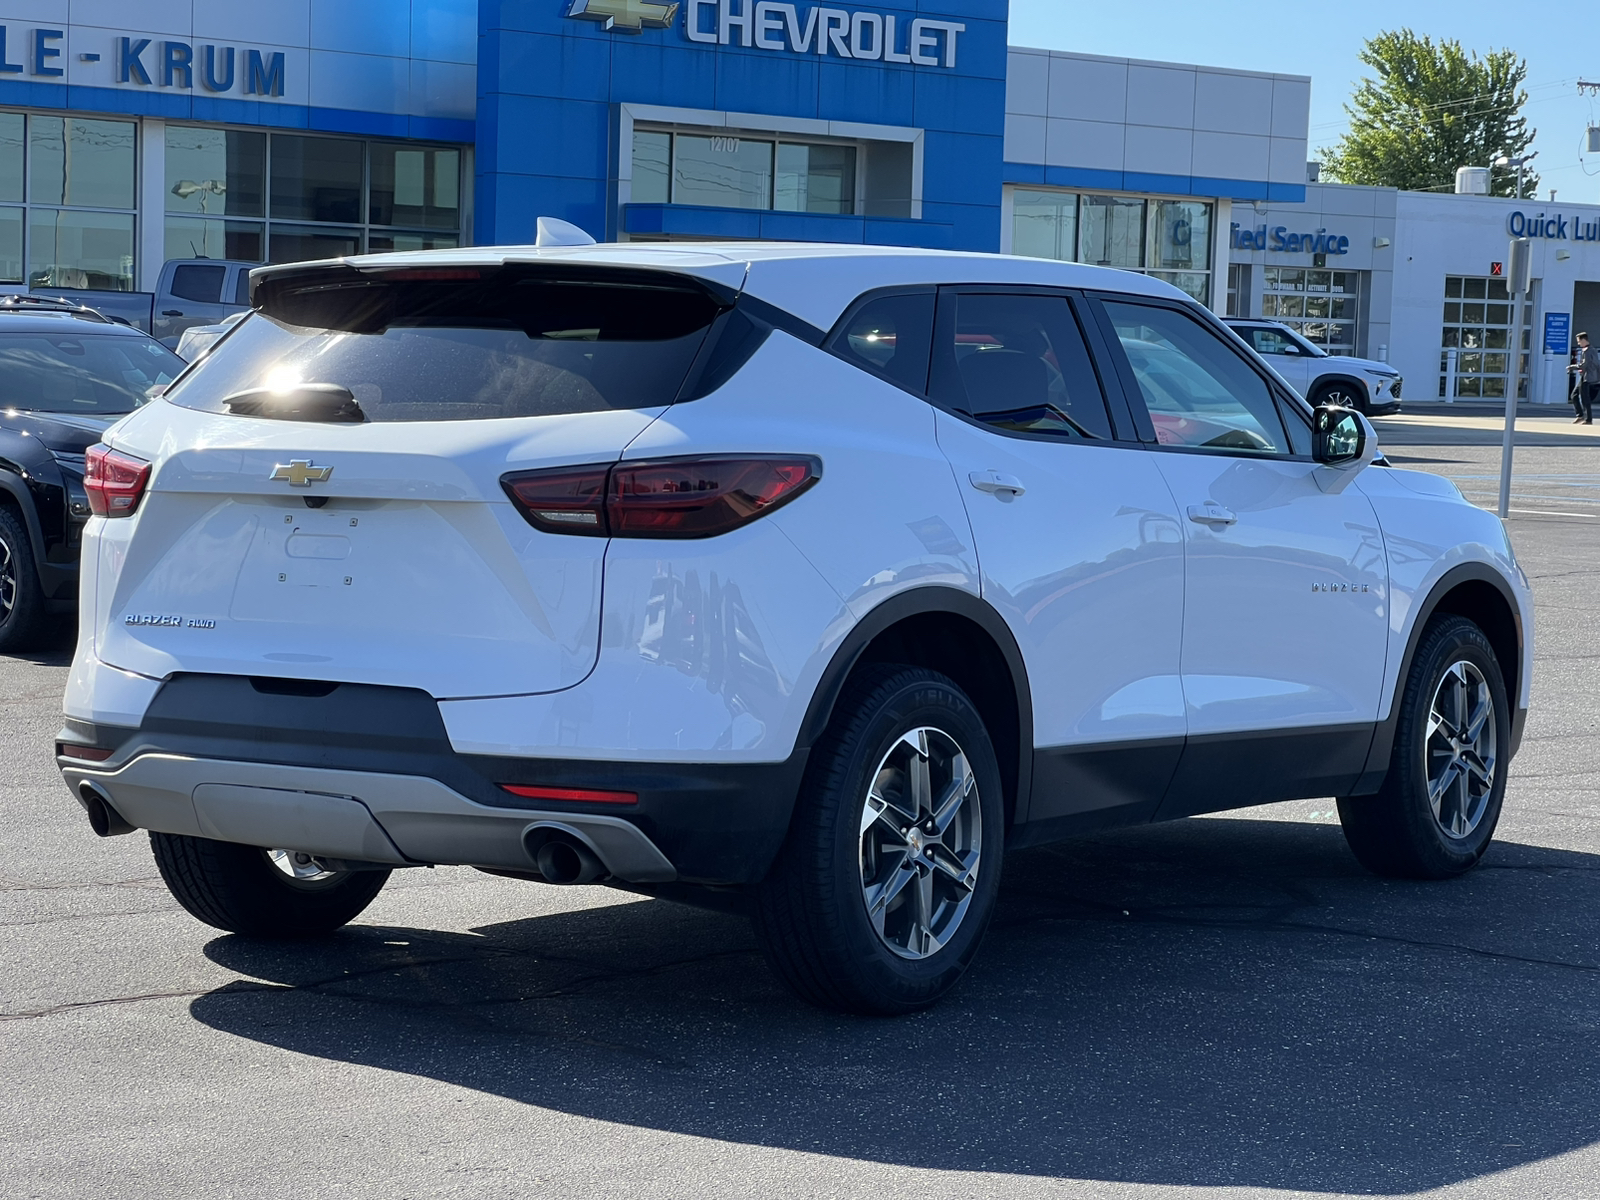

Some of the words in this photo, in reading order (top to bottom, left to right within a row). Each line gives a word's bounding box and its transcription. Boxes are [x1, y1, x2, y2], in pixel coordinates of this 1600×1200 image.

[687, 0, 966, 68] CHEVROLET
[709, 136, 740, 153] 12707
[1507, 211, 1568, 239] Quick
[1270, 225, 1349, 255] Service
[1311, 582, 1369, 593] BLAZER
[125, 614, 182, 627] BLAZER
[186, 618, 216, 629] AWD
[914, 689, 966, 712] KELLY
